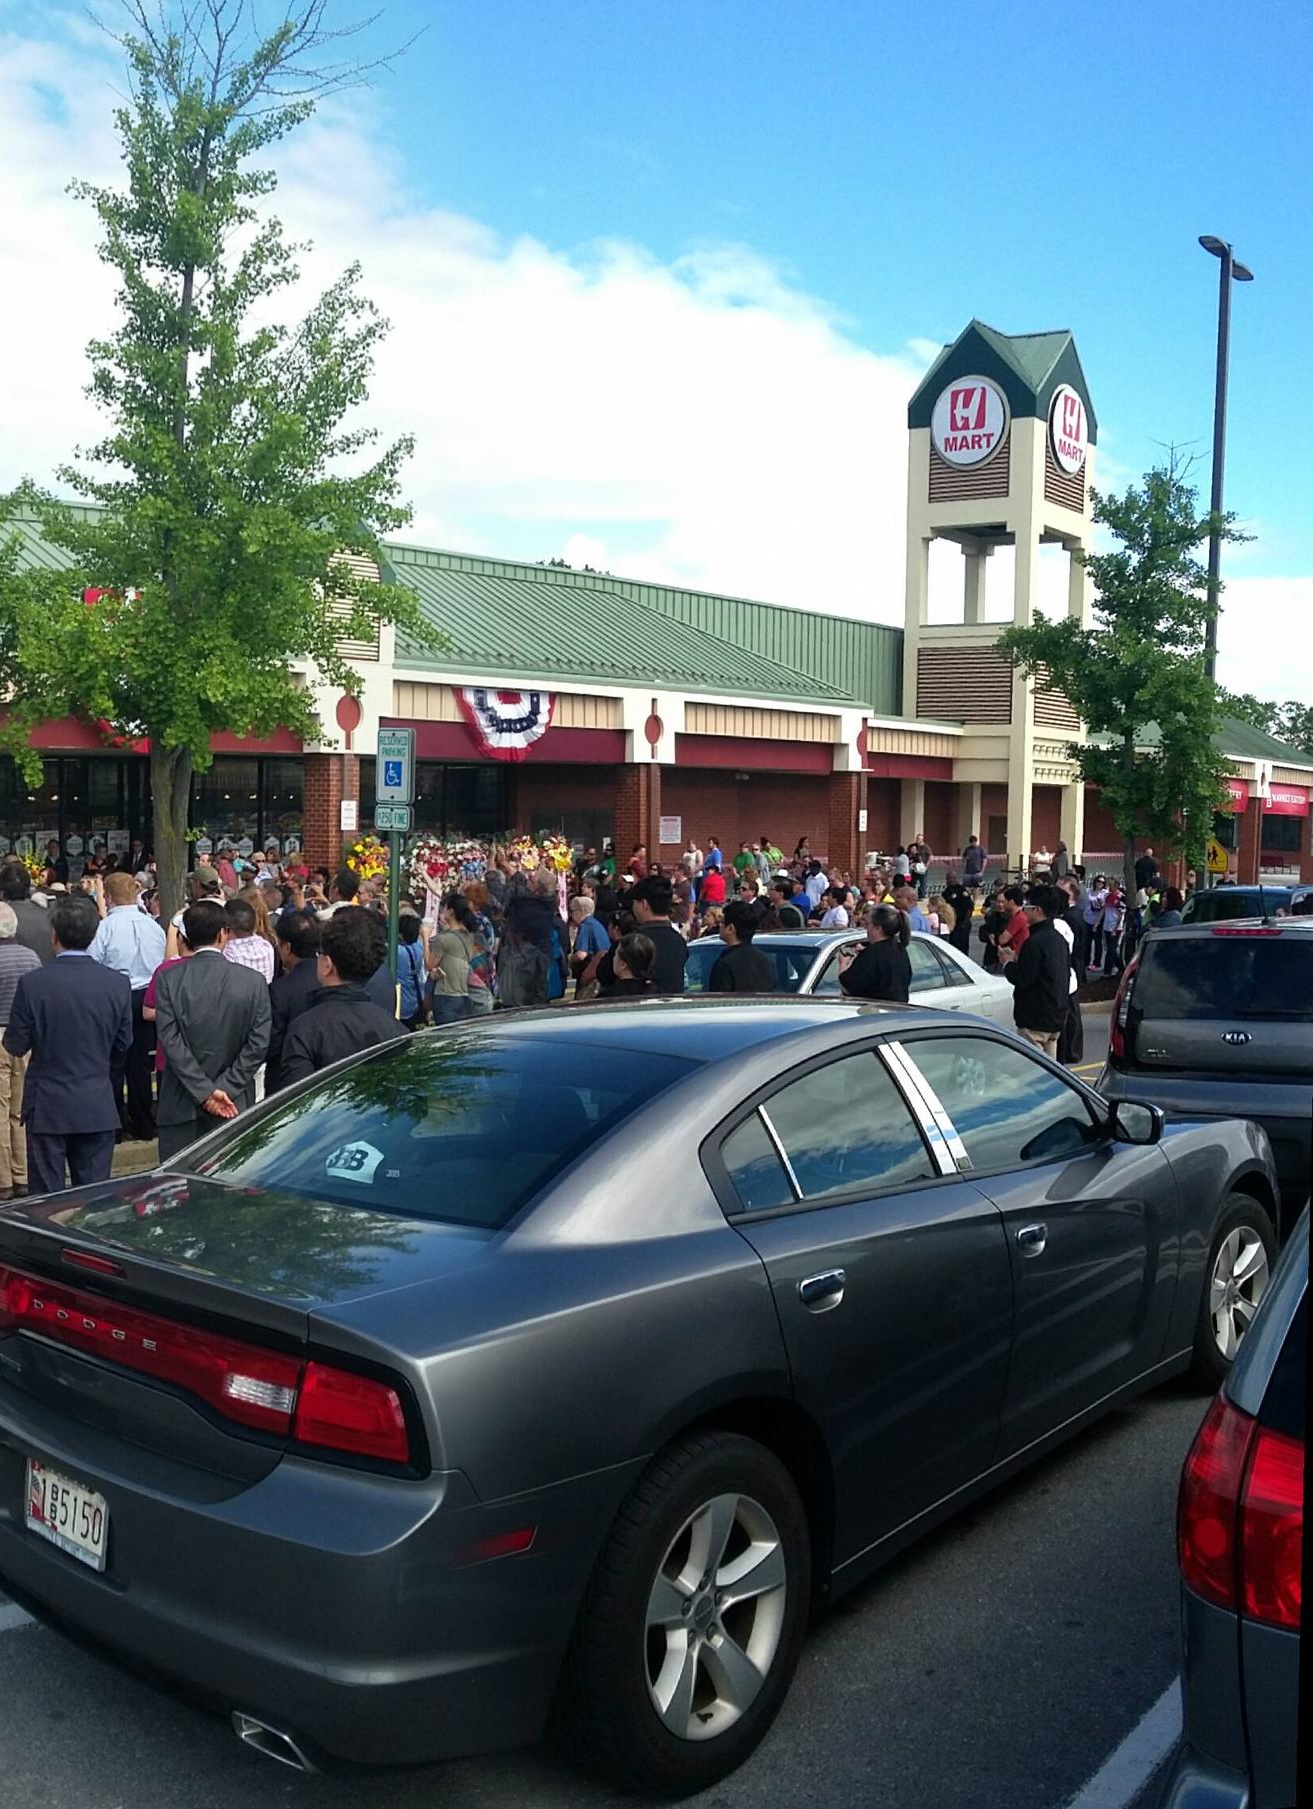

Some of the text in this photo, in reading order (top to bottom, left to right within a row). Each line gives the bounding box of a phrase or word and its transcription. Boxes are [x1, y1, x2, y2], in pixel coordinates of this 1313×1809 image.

[944, 433, 994, 452] MART
[1058, 438, 1083, 462] MART
[379, 736, 409, 746] RESERVED
[382, 747, 406, 757] PARKING
[1225, 1032, 1247, 1044] KIA
[33, 1298, 158, 1352] DODGE
